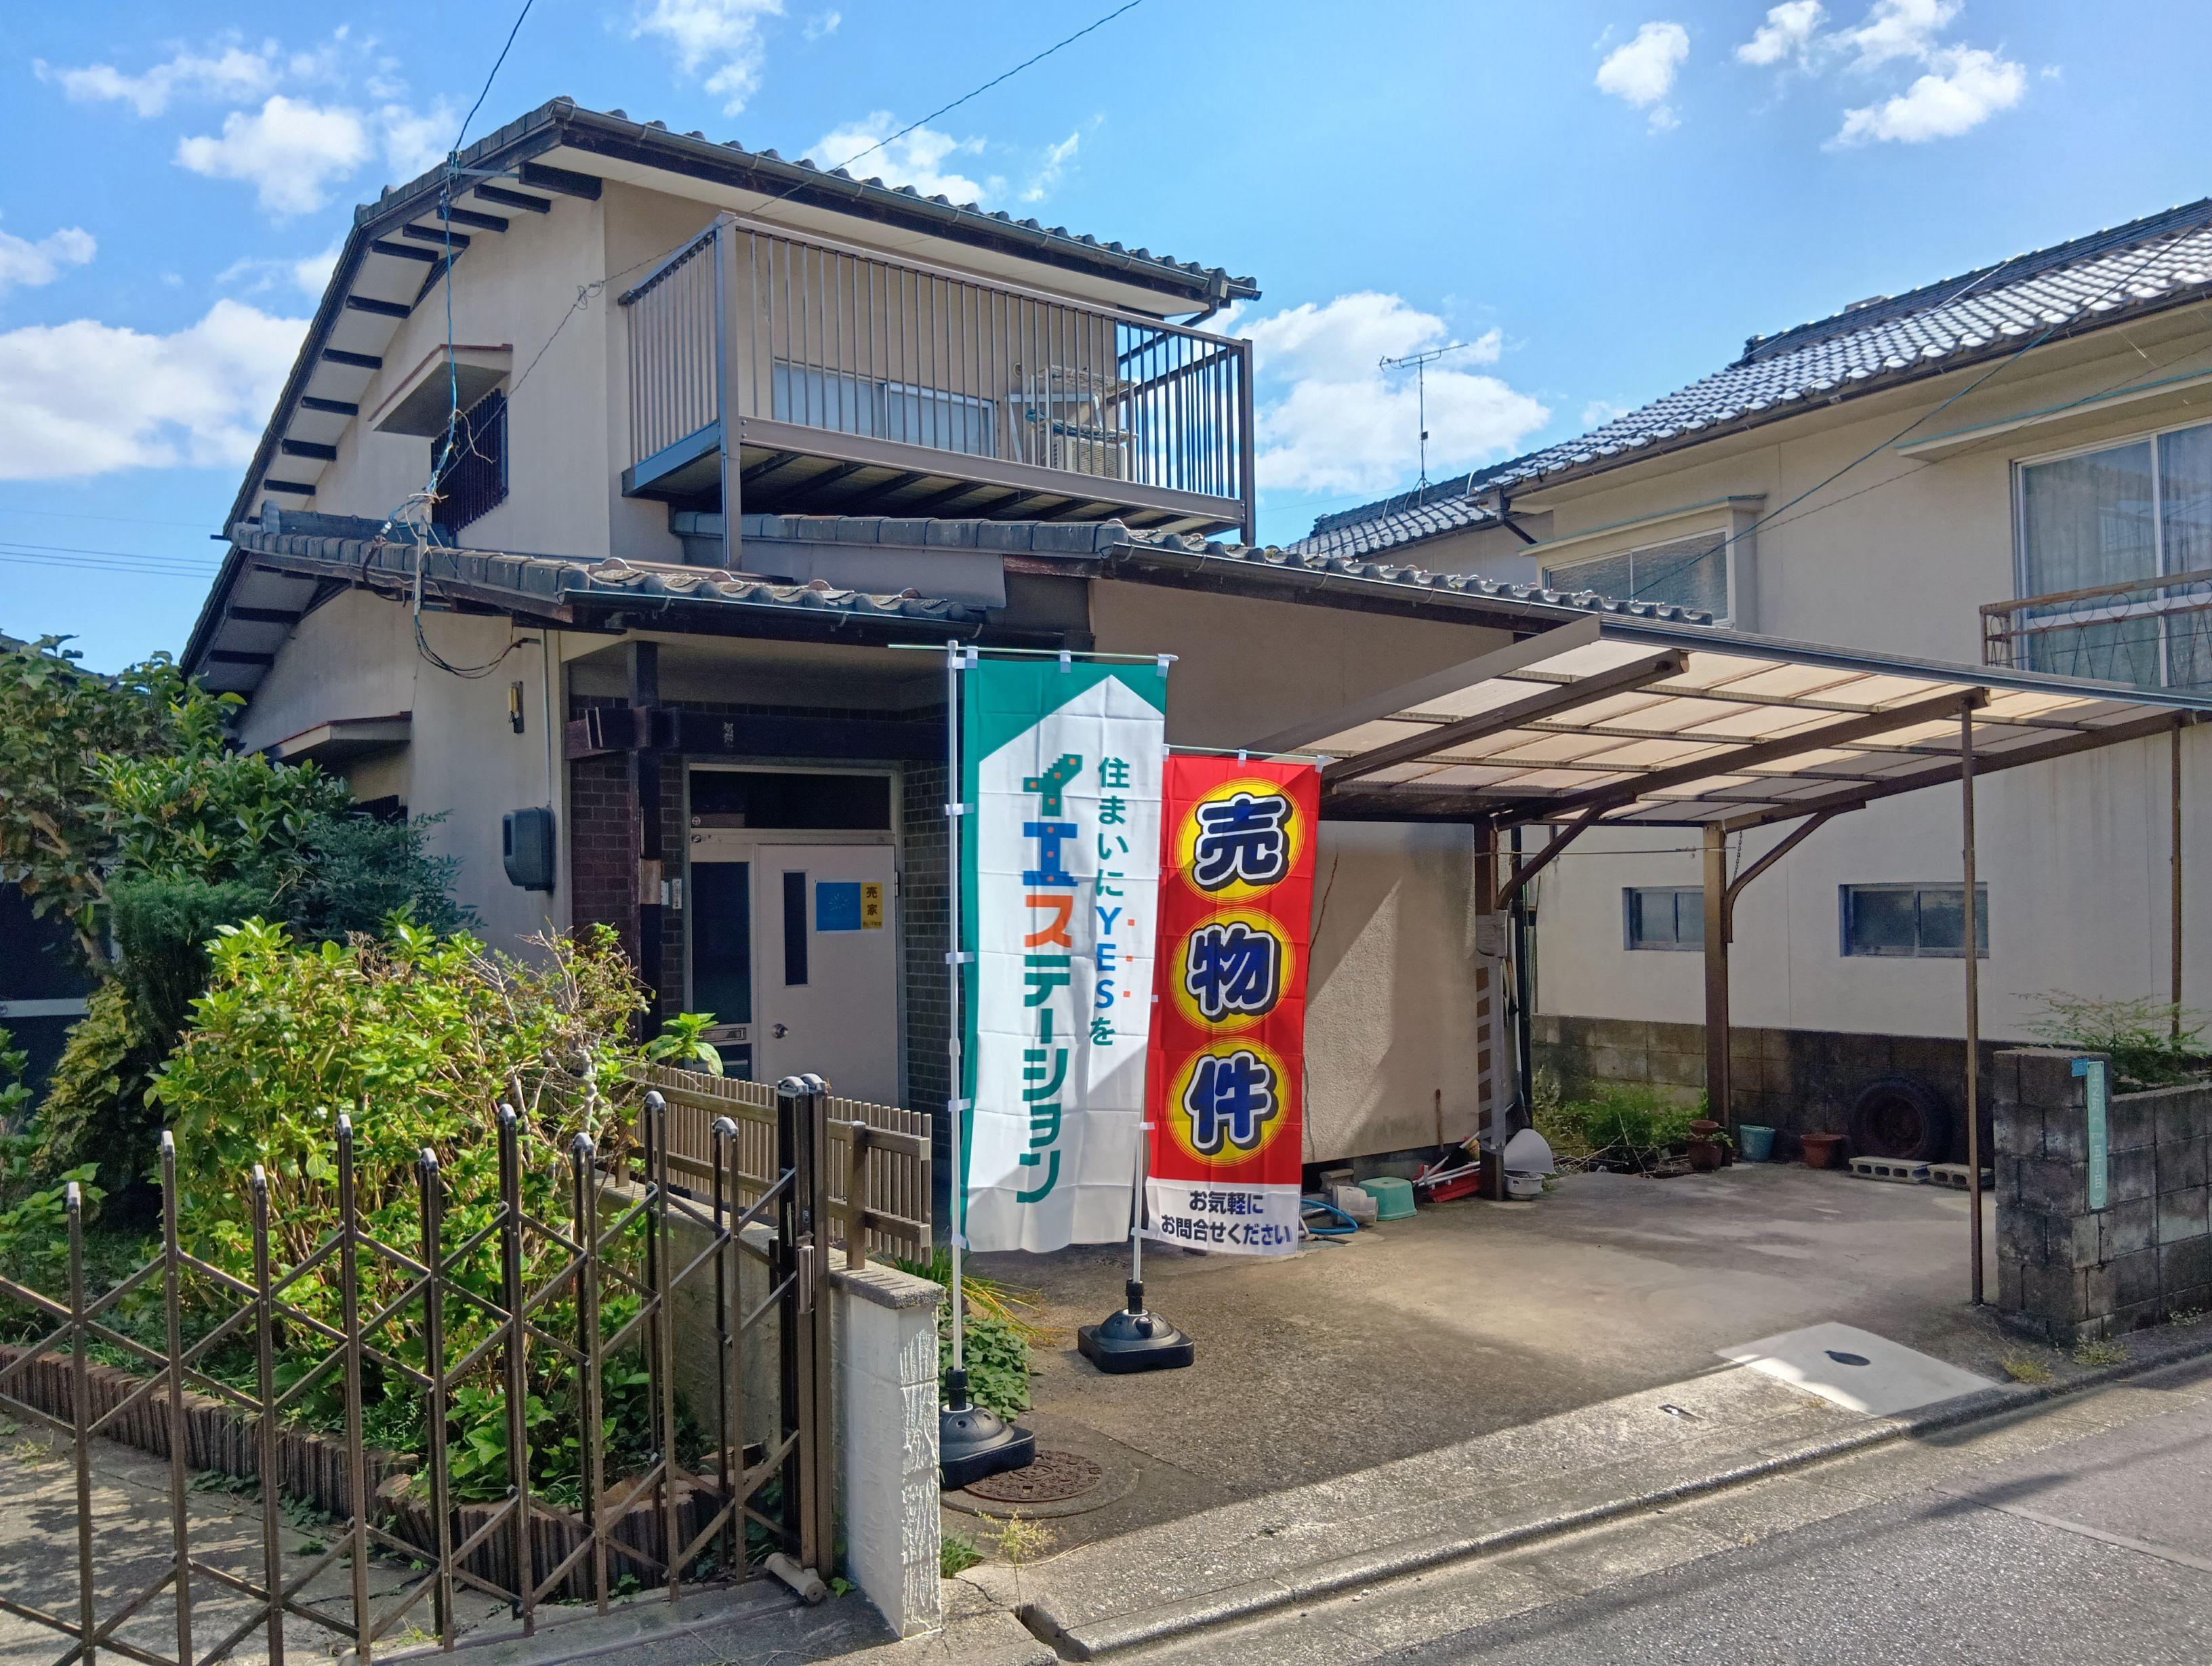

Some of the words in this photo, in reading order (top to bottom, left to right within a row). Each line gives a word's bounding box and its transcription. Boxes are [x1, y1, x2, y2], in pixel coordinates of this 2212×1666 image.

[866, 886, 878, 916] 売家
[1017, 753, 1084, 1203] イエステーション
[1089, 756, 1131, 1046] 住まいにYESを
[1183, 792, 1293, 1155] 売物件
[1161, 1214, 1293, 1246] お問合せください
[1189, 1190, 1264, 1215] お気軽に
